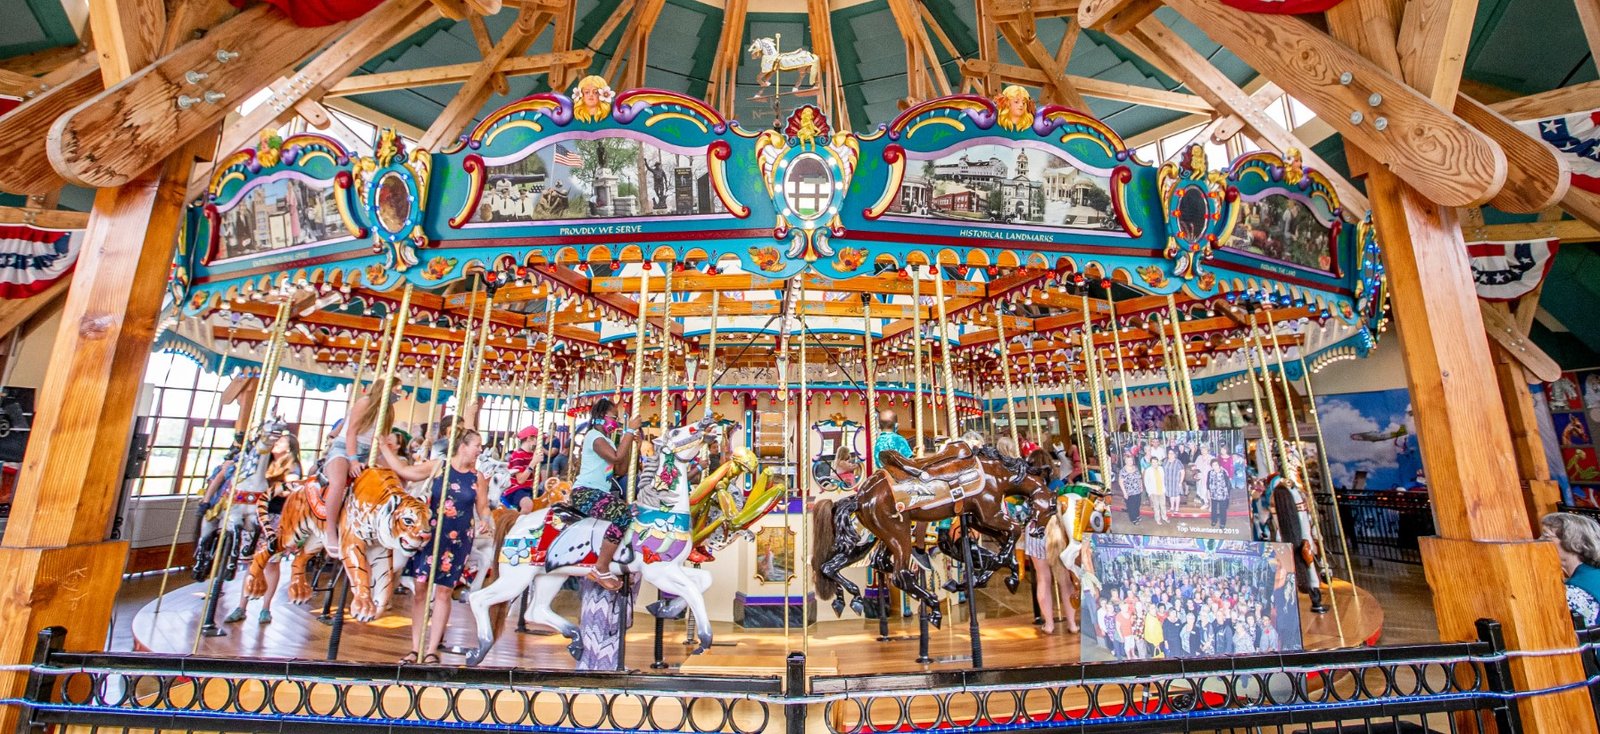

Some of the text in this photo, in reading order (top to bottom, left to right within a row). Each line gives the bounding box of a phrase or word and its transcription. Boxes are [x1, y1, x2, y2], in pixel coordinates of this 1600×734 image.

[560, 225, 642, 235] PROUDLY WE SERVE
[960, 229, 1054, 242] HISTORICAL LANDMARKS
[1177, 525, 1240, 535] Top Volunteers 2019
